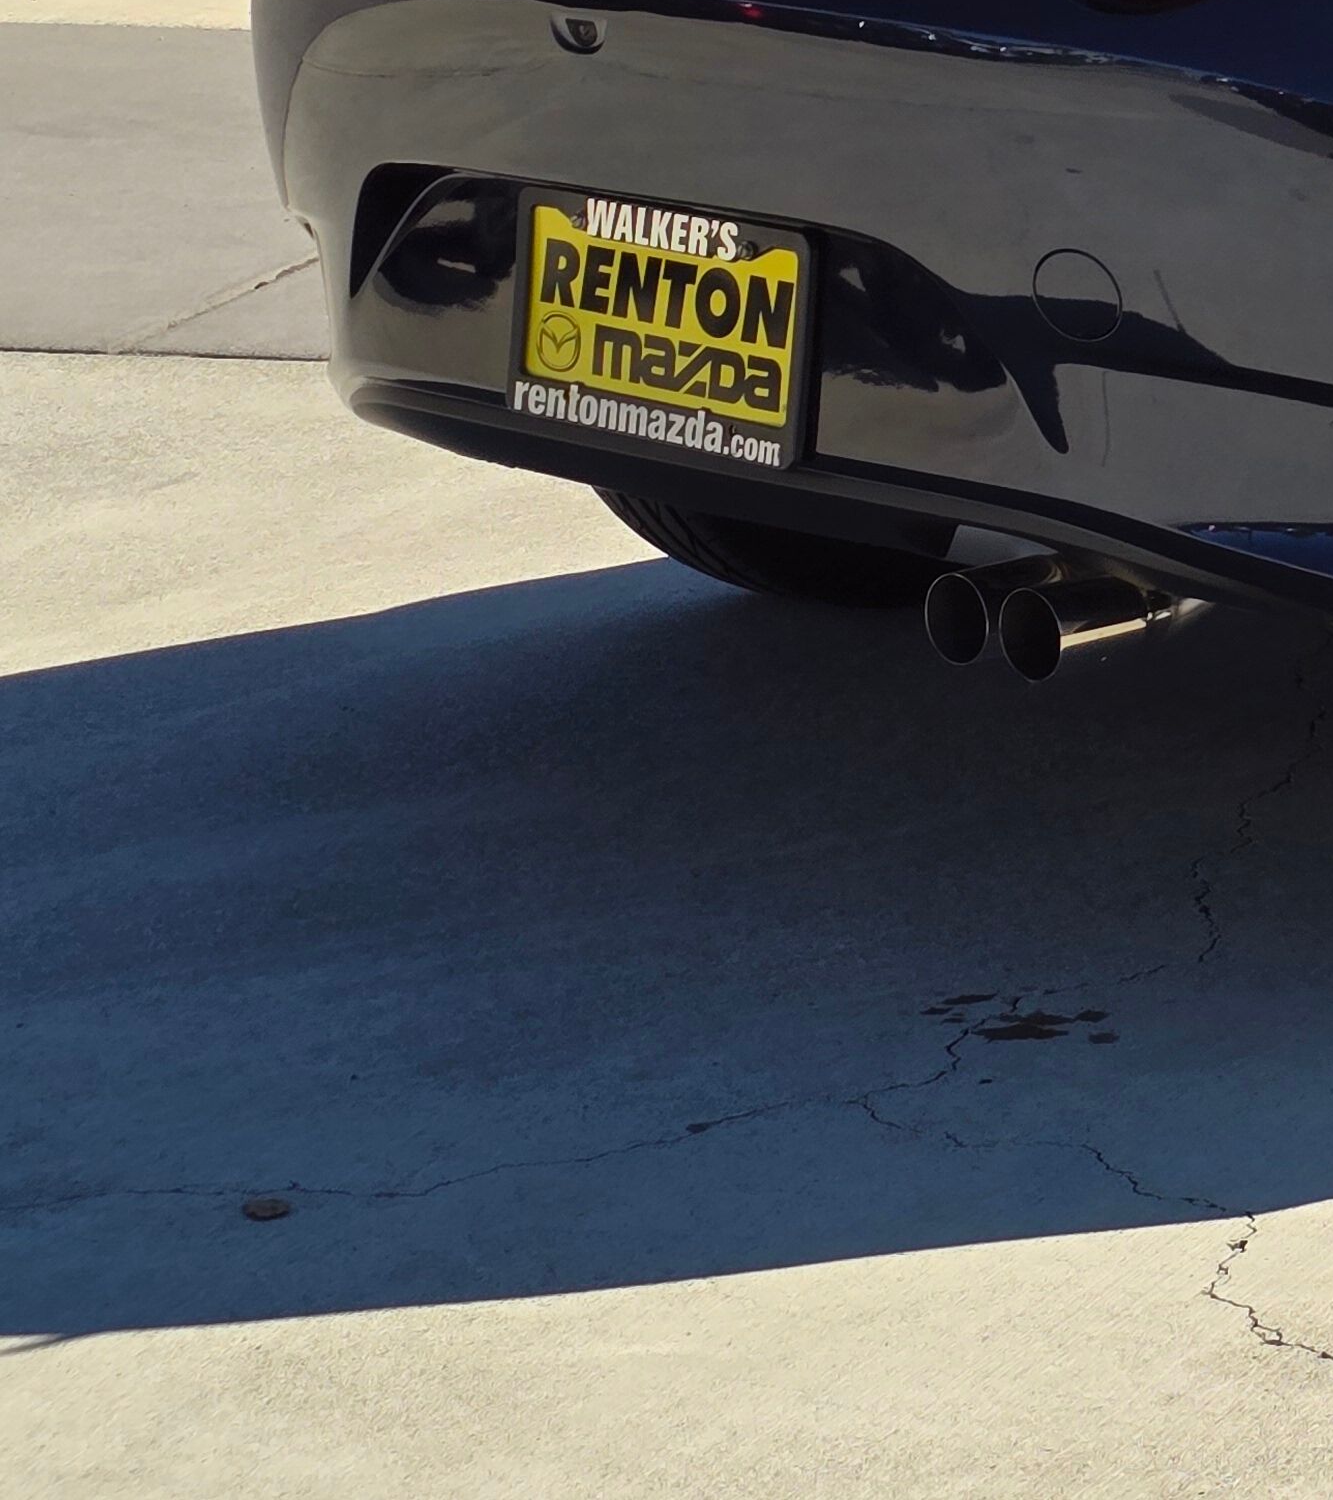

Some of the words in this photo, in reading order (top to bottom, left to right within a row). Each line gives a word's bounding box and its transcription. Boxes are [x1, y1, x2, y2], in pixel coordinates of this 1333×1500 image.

[585, 198, 739, 262] WALKER'S
[539, 237, 795, 349] RENTON
[591, 323, 783, 413] mazda
[512, 380, 781, 467] rentonmazda.com
